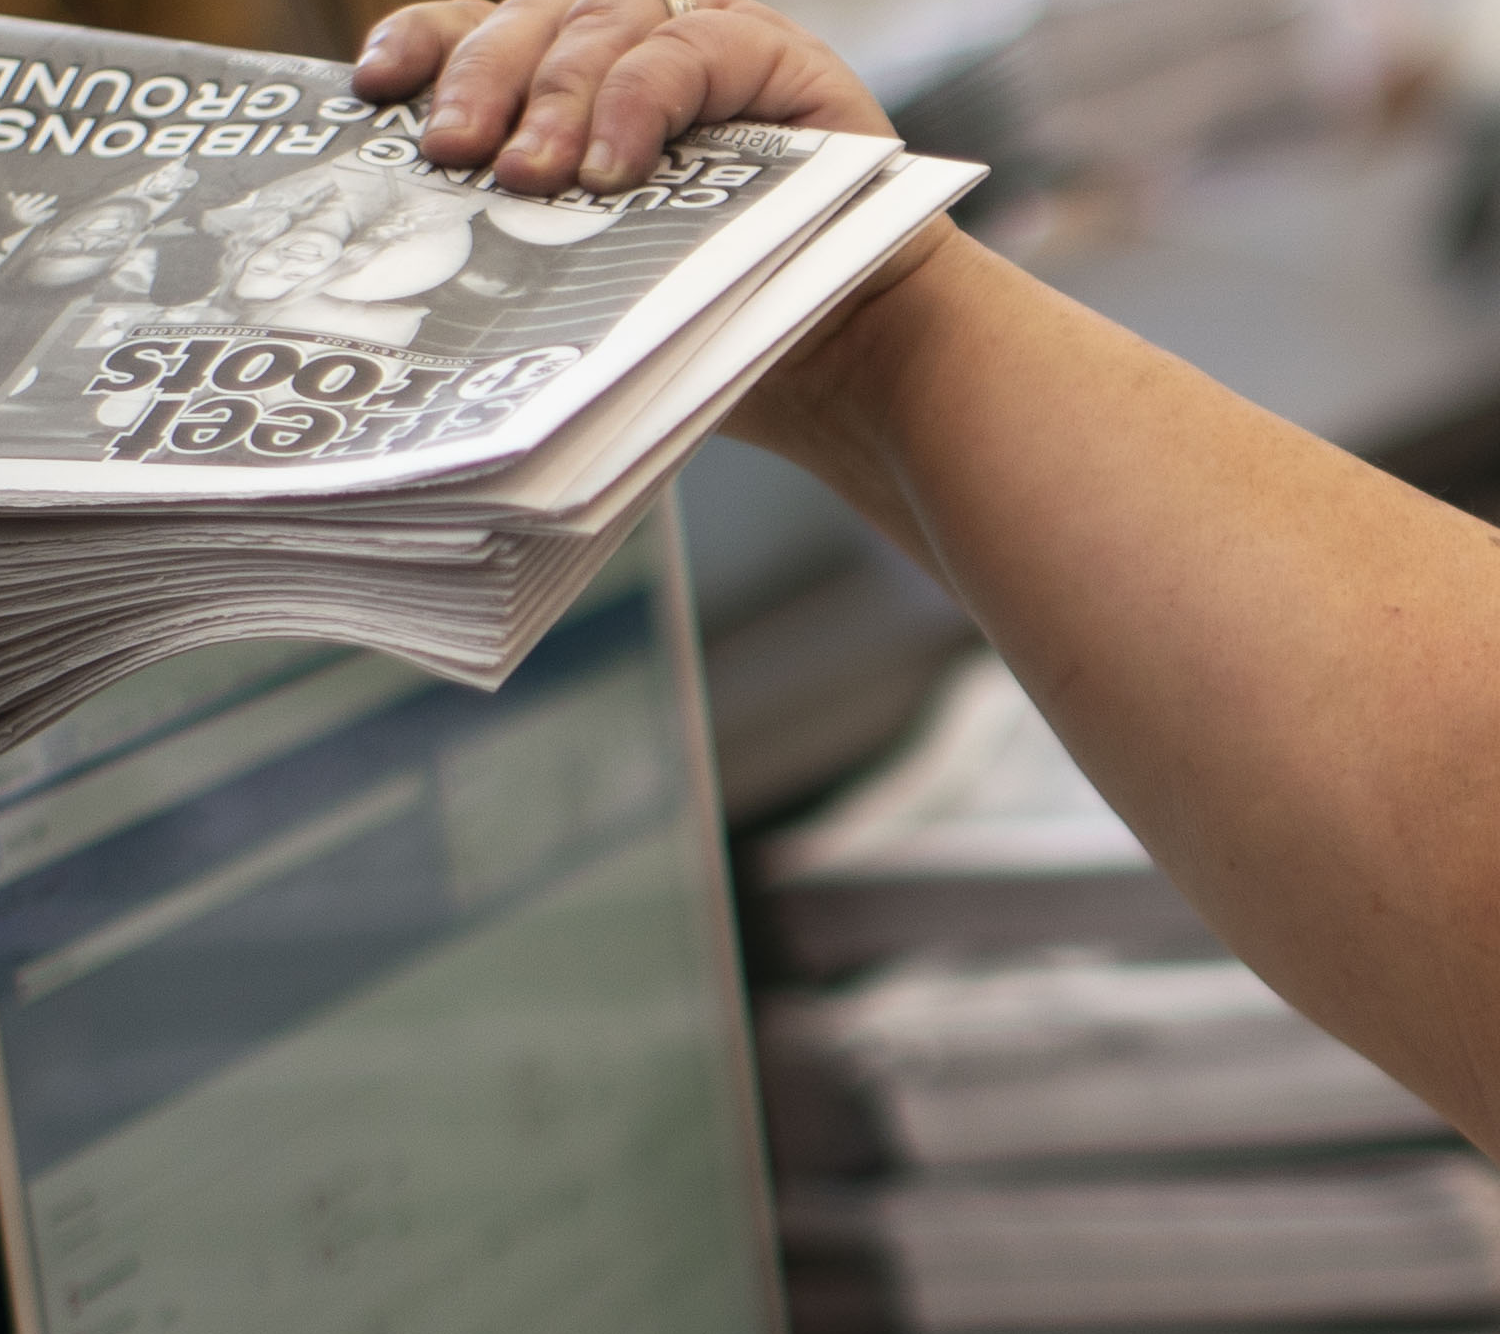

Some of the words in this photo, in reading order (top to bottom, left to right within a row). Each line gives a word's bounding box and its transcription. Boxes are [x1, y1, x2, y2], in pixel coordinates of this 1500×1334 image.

[708, 126, 792, 158] Metro
[82, 337, 463, 415] roots
[392, 348, 474, 366] NOVEMBER
[101, 394, 517, 462] street
